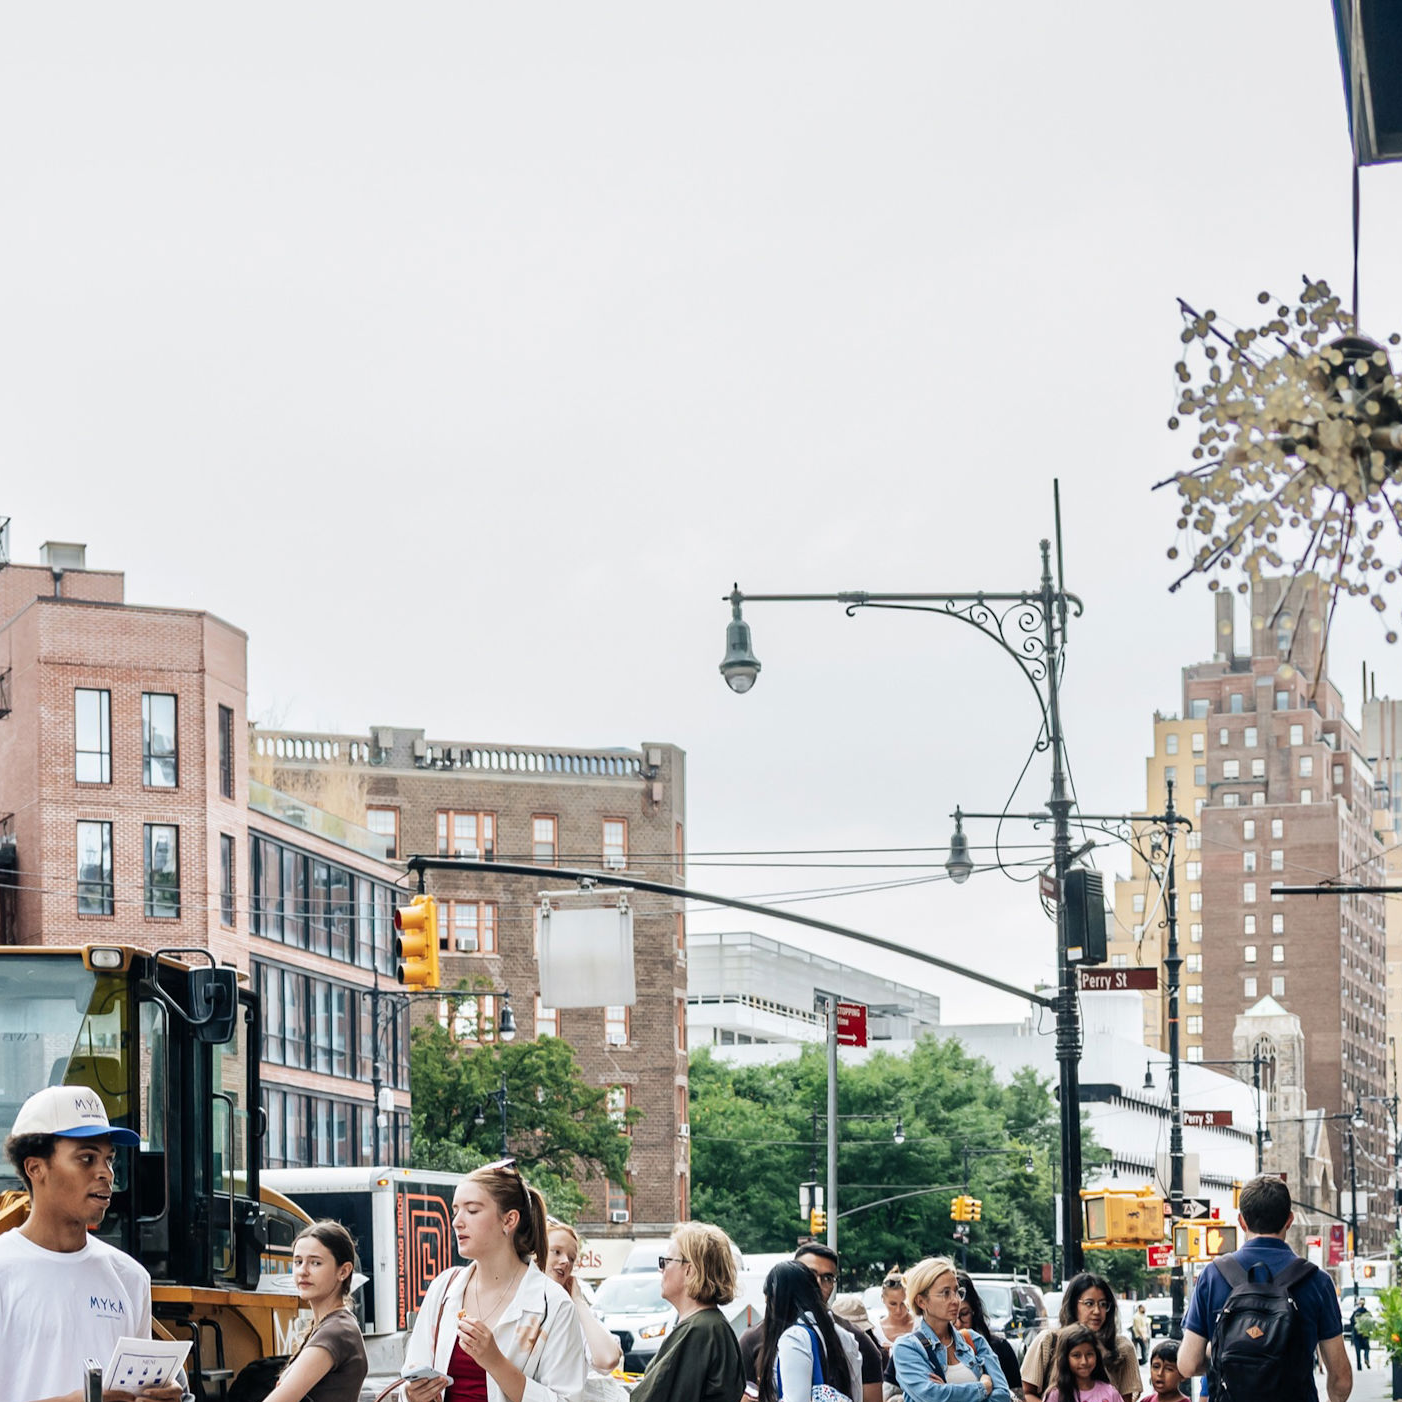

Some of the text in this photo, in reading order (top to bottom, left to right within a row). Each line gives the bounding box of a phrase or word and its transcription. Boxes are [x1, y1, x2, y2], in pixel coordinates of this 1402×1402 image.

[1082, 971, 1127, 991] Perry St
[1184, 1112, 1215, 1127] Perry St
[90, 1296, 125, 1314] MYKA
[398, 1276, 406, 1329] LIGHTING
